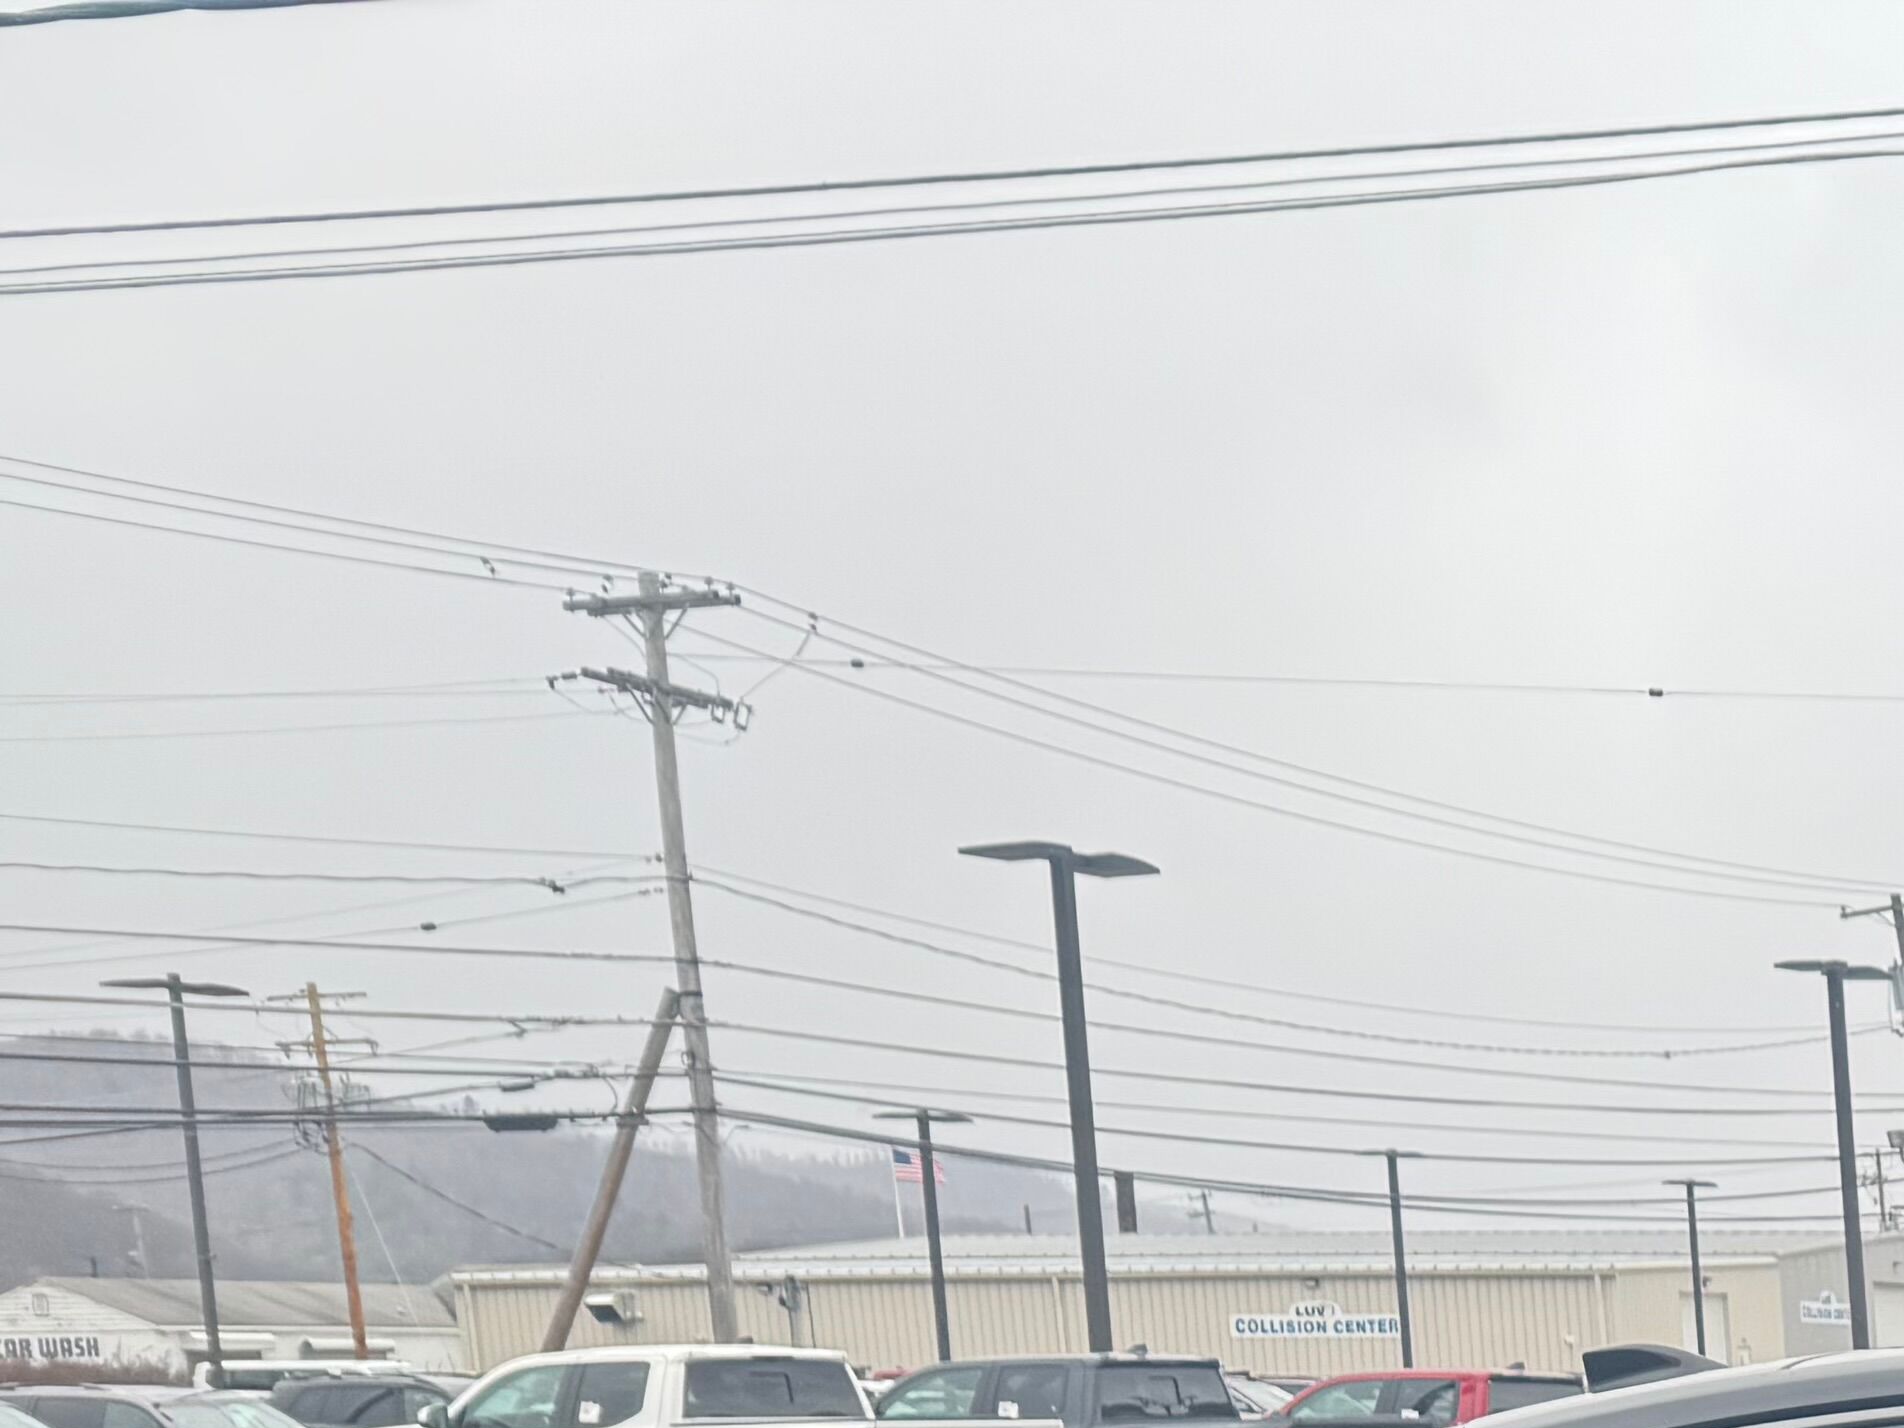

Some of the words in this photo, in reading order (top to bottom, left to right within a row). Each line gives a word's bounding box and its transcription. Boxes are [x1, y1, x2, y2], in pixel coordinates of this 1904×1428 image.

[1235, 1318, 1327, 1334] COLLISION
[1333, 1319, 1399, 1334] CENTER
[0, 1338, 32, 1359] AR
[38, 1336, 100, 1359] WASH
